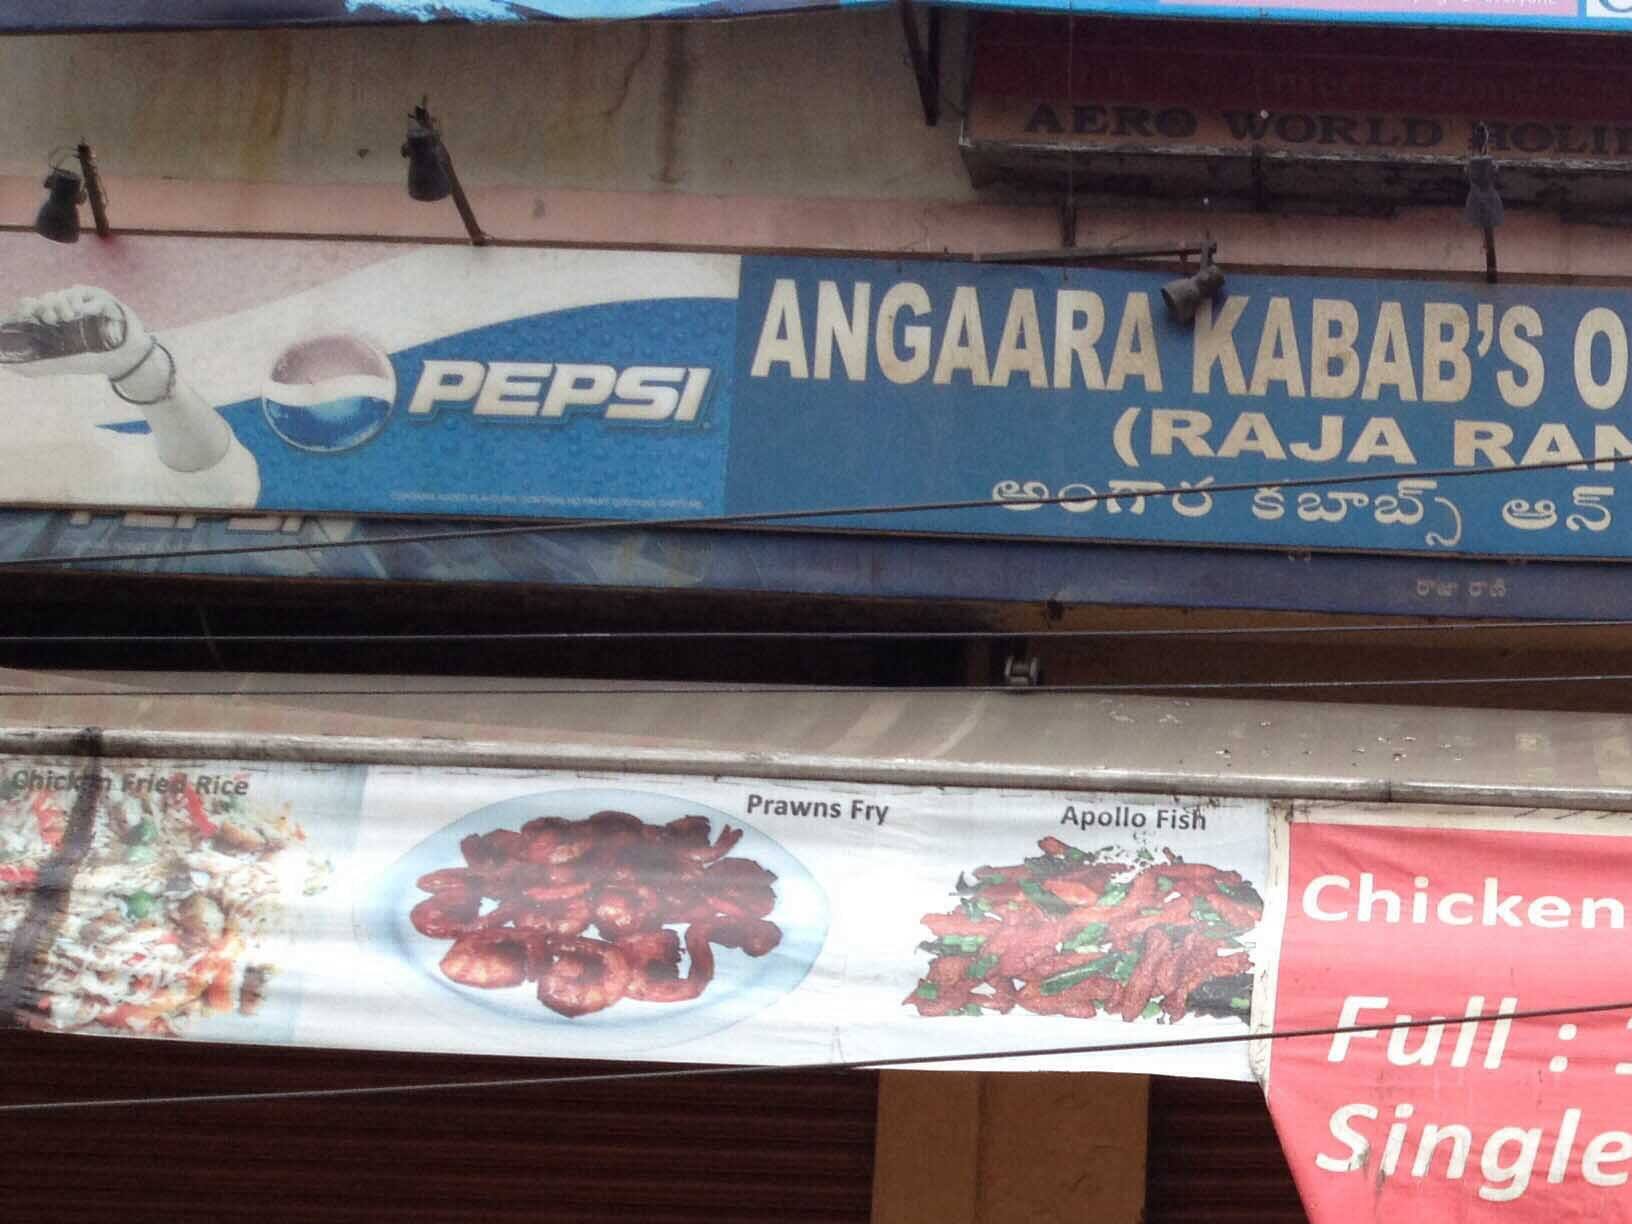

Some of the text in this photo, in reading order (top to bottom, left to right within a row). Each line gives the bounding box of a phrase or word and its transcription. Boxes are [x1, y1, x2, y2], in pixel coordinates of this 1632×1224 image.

[1025, 103, 1198, 139] AERO
[1222, 109, 1444, 148] WORLD
[750, 278, 1164, 393] ANGAARA
[1191, 298, 1546, 409] KABAB'S
[408, 359, 713, 423] PEPSI
[1113, 405, 1418, 469] (RAJA
[12, 769, 113, 793] Chickn
[195, 774, 250, 796] Rice
[746, 793, 890, 827] Prawns Fry
[1060, 805, 1208, 832] Apollo Fish
[1300, 873, 1627, 931] Chicken
[1326, 995, 1519, 1071] Full
